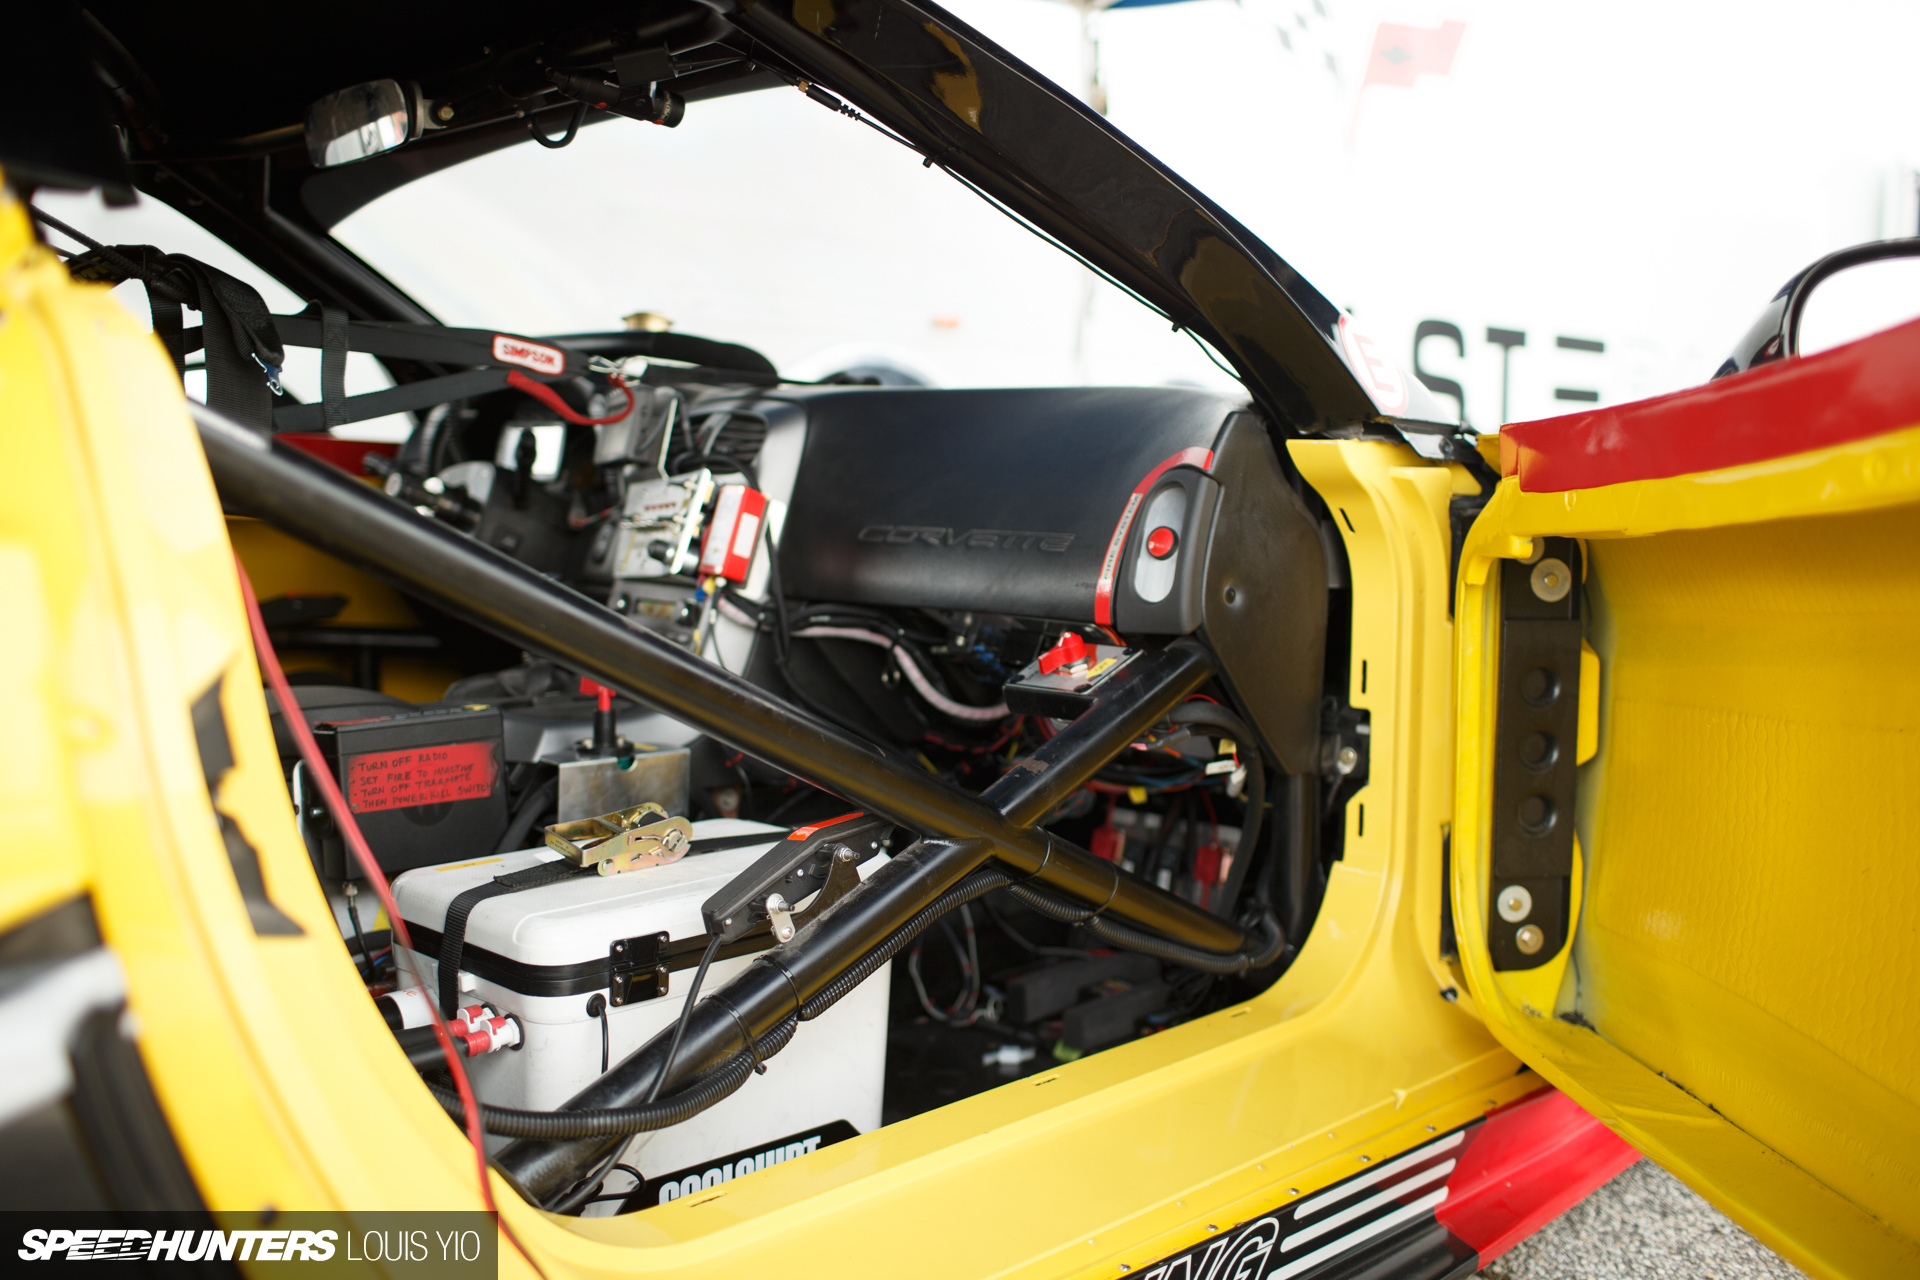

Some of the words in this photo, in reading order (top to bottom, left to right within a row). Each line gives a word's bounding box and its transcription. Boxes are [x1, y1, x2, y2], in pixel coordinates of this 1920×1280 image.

[503, 344, 555, 366] SIMPSON
[1351, 332, 1397, 394] E
[857, 524, 1076, 553] CORVETTE
[1103, 550, 1117, 580] FIRE
[1114, 495, 1139, 546] SYSTEM
[358, 761, 388, 772] TURN
[391, 756, 412, 768] OFF
[418, 752, 448, 763] RADIO
[361, 776, 378, 786] SET
[387, 771, 412, 782] FIRE
[416, 769, 428, 778] TO
[433, 763, 475, 776] INACTIVE
[361, 786, 385, 798] TURN
[391, 783, 409, 793] OFF
[363, 798, 387, 808] THEN
[392, 793, 427, 806] POWER
[430, 789, 451, 800] KILL
[458, 782, 494, 795] SWITCH
